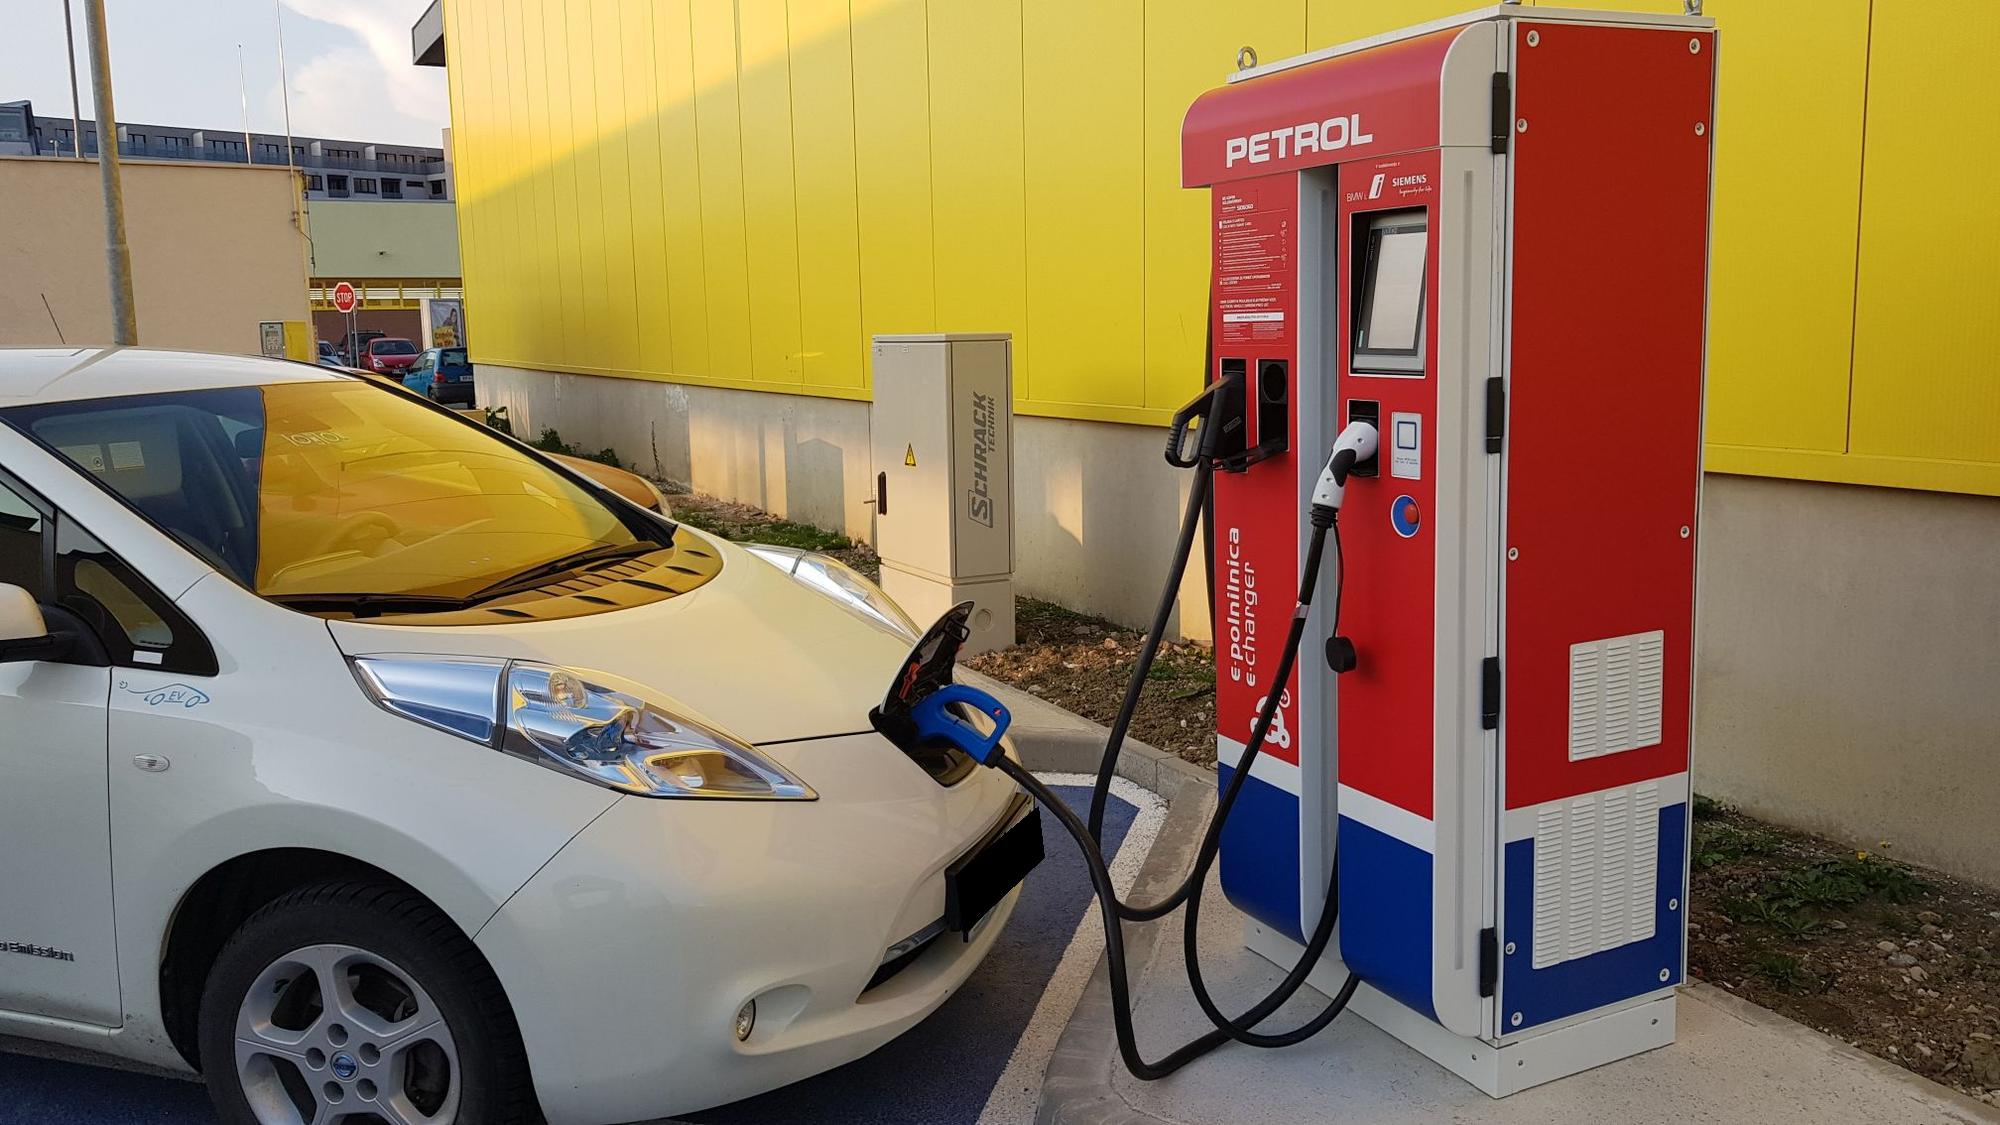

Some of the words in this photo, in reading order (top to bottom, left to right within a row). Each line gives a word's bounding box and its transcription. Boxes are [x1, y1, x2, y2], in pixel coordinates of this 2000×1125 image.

[1226, 113, 1373, 168] PETROL
[1392, 174, 1427, 187] SIEMENS
[336, 292, 352, 303] STOP
[987, 397, 996, 453] TECHNIK
[970, 391, 990, 524] SCHRACK
[169, 691, 187, 701] EV
[9, 941, 74, 961] Emission
